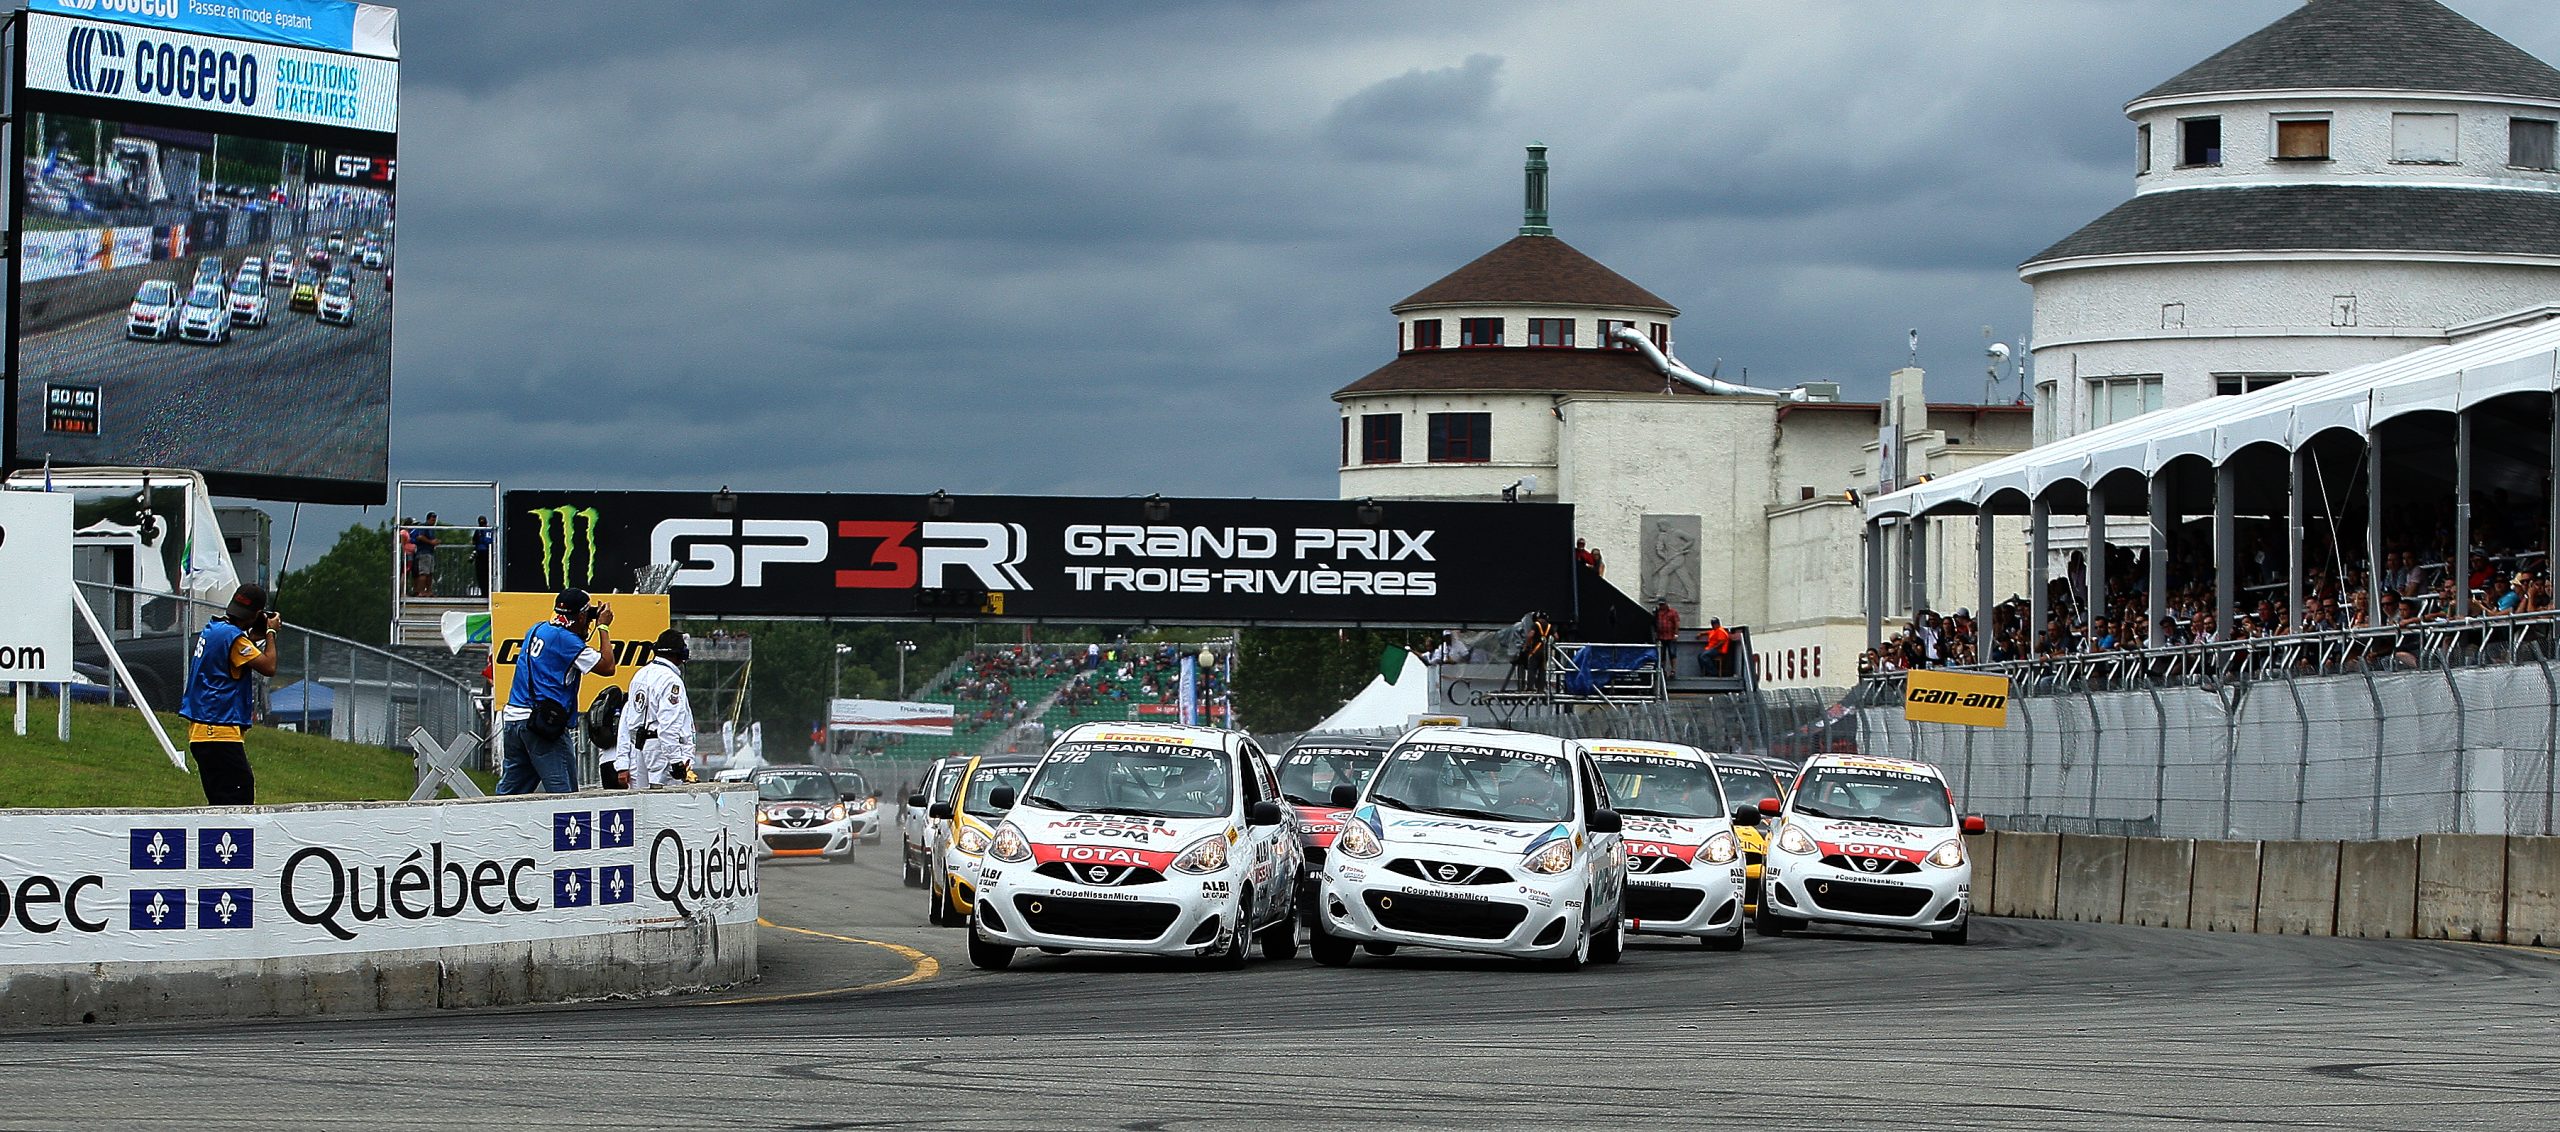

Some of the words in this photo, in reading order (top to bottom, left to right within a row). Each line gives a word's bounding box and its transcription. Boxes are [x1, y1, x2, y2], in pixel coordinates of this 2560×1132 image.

[189, 0, 226, 17] Passez
[228, 9, 240, 18] en
[242, 9, 272, 24] mode
[275, 10, 313, 30] épatant
[276, 57, 358, 92] SOLUTIONS
[275, 87, 357, 120] D'AFFAIRES
[1064, 524, 1277, 559] GRAND
[1295, 527, 1436, 562] PRIX
[650, 518, 1034, 591] GP3R
[1908, 687, 2006, 709] can-am
[1048, 751, 1091, 764] 572
[1069, 744, 1151, 753] NISSAN
[1156, 746, 1215, 760] MICRA
[1297, 748, 1369, 757] NISSAN
[1398, 750, 1425, 761] 69
[1414, 744, 1494, 756] NISSAN
[1500, 750, 1558, 766] MICRA
[1289, 755, 1313, 765] 40
[1646, 757, 1697, 769] MICRA
[982, 767, 1035, 775] NISSAN
[1718, 767, 1761, 778] MICRA
[1819, 768, 1881, 777] NISSAN
[1886, 771, 1931, 784] MICRA
[759, 776, 774, 784] 27
[942, 774, 954, 785] 7
[1066, 814, 1166, 827] ALBI
[1048, 821, 1177, 837] NISSAN
[1825, 825, 1923, 840] NISSAN
[1056, 845, 1149, 866] TOTAL
[1834, 842, 1909, 860] TOTAL
[650, 827, 753, 917] Québec
[980, 867, 1003, 880] ALBI
[1202, 881, 1229, 892] ALBI
[1835, 874, 1904, 886] #CoupeNissanMicra
[280, 842, 541, 941] Québec
[1049, 888, 1139, 901] #CoupeNissanMicra
[1401, 885, 1489, 902] #CoupeNissanMicra
[1528, 888, 1551, 897] TOTAL
[0, 875, 109, 933] ec
